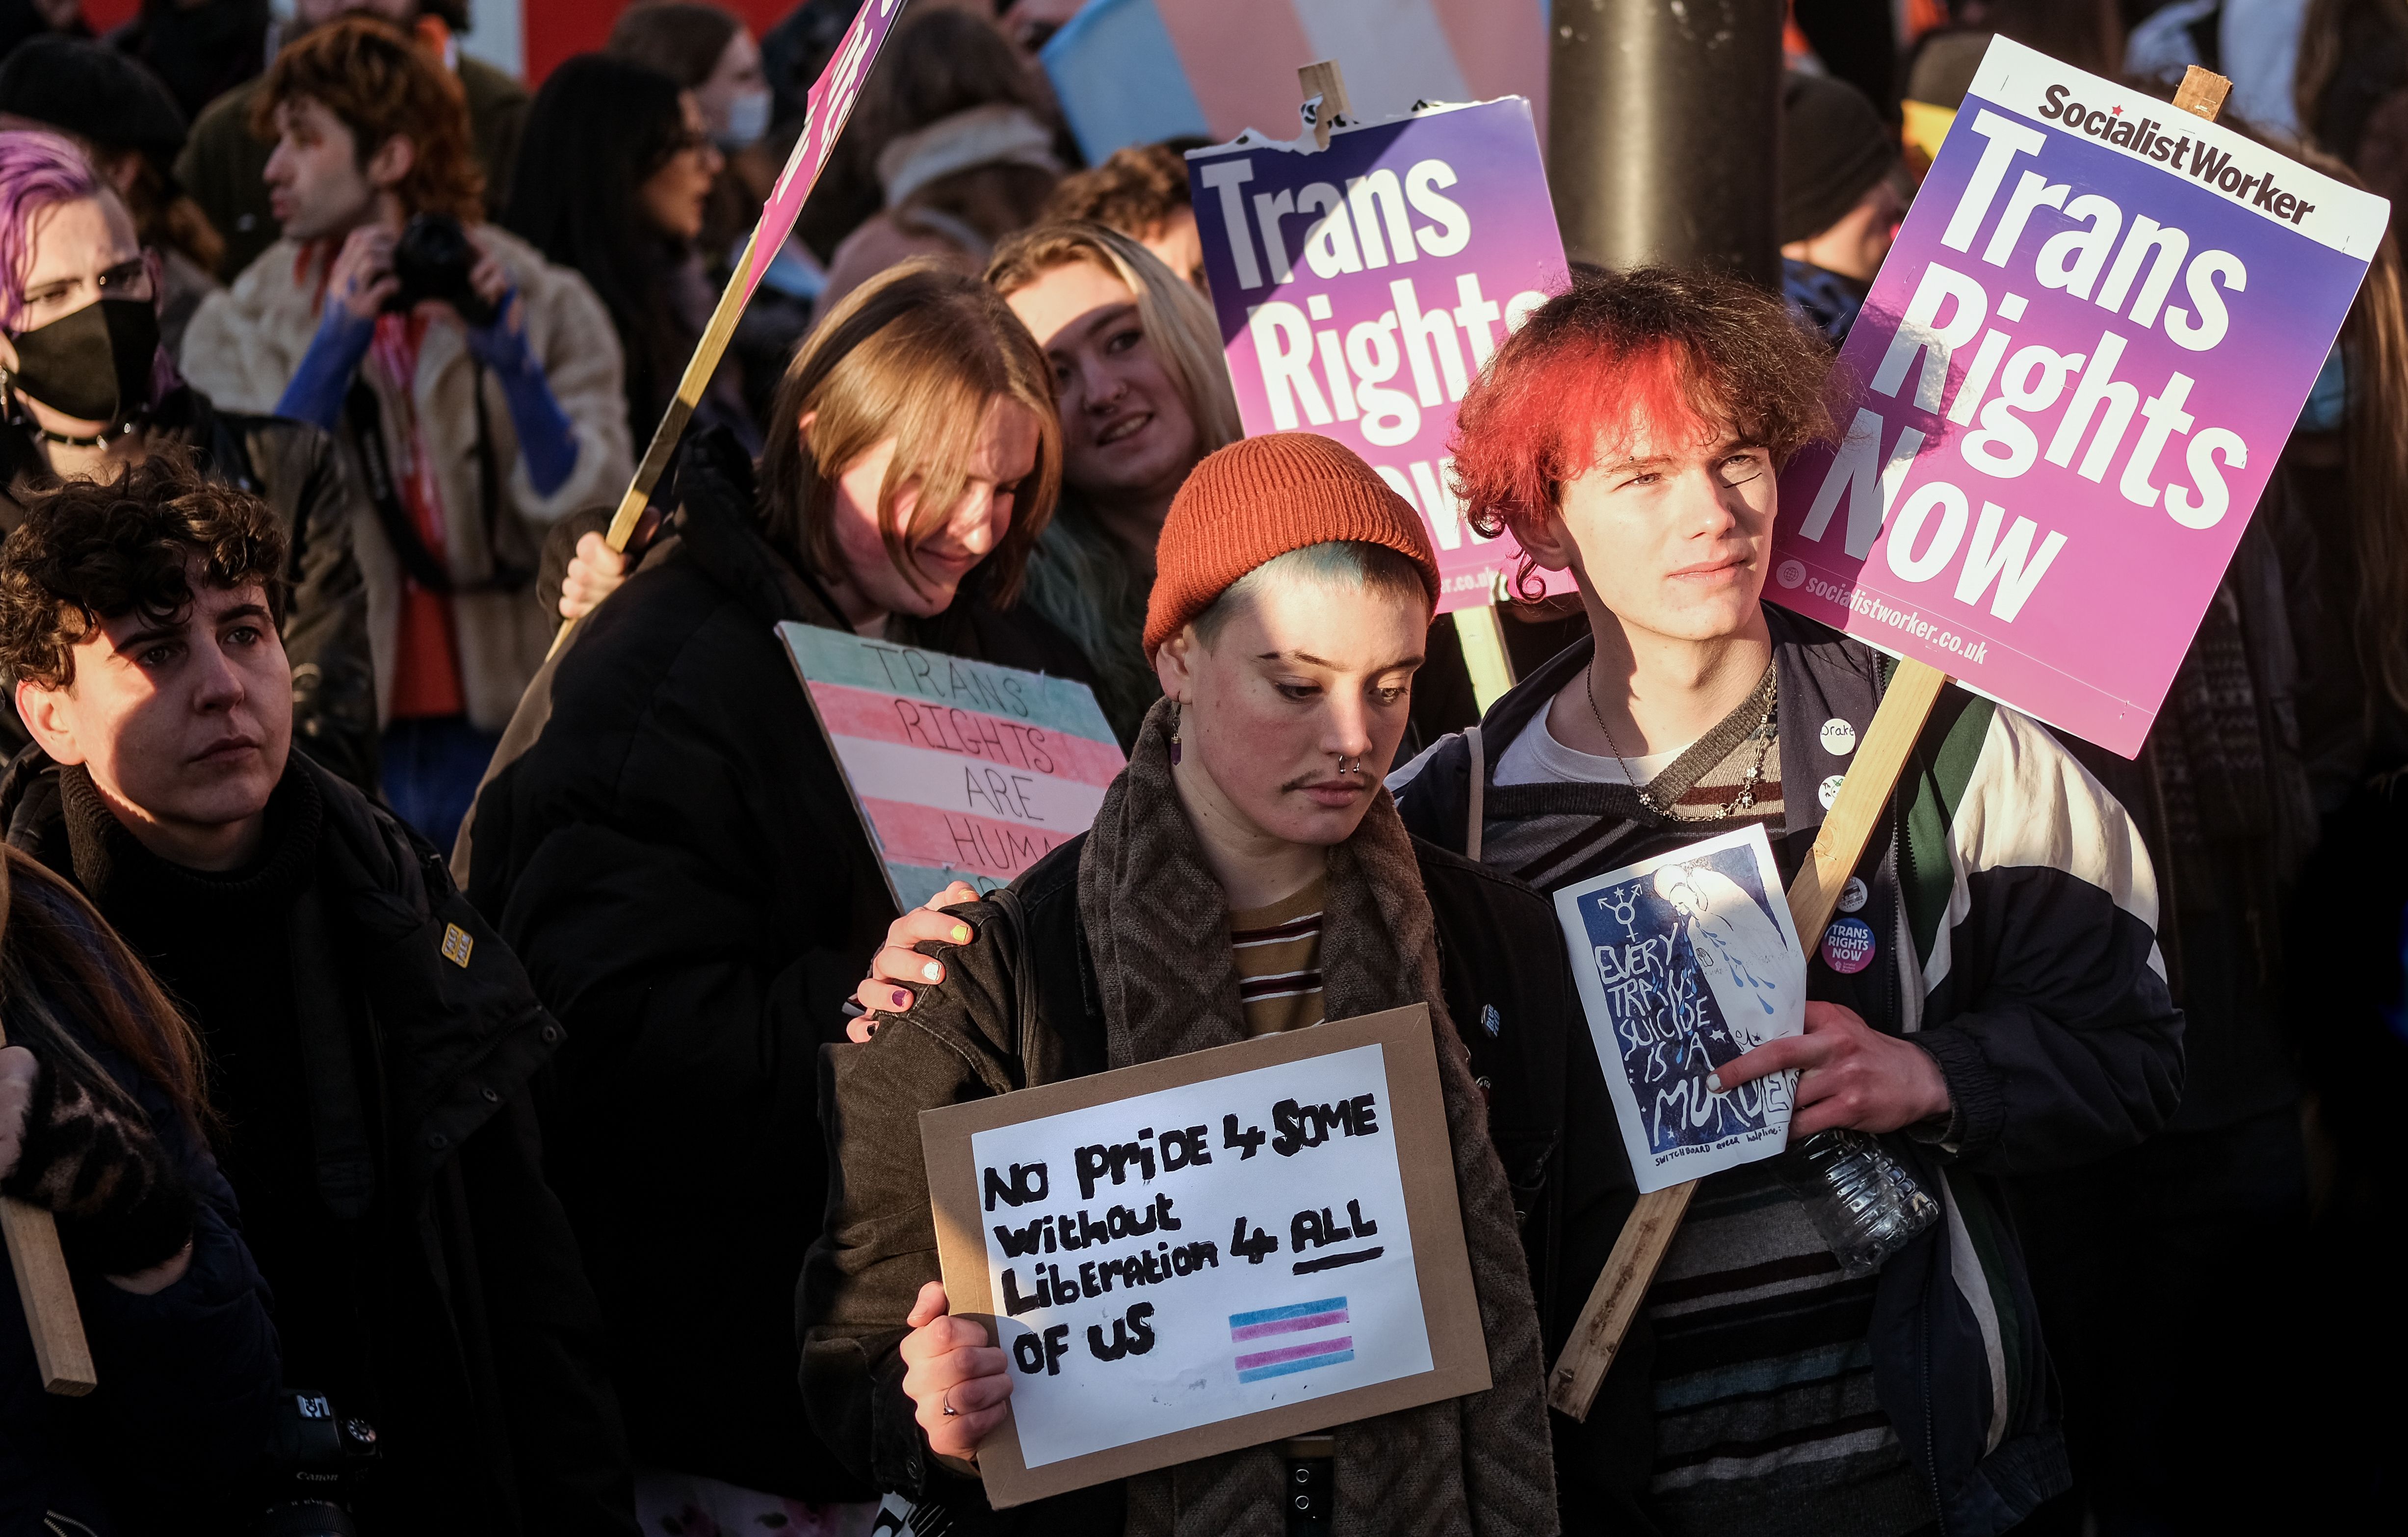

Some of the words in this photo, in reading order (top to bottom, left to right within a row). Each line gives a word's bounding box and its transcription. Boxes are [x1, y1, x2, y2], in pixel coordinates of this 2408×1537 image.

[1200, 158, 1471, 290] Trans
[1940, 108, 2248, 352] Trans
[1248, 273, 1550, 447] Right
[1870, 261, 2250, 530] Rights
[1798, 407, 2068, 624] Now
[1806, 576, 1989, 665] socialistworker.co.uk
[861, 643, 1028, 717] TRANS
[894, 699, 1054, 774] RIGHTS
[964, 766, 1045, 821] ARE
[445, 927, 459, 954] THEY
[1595, 922, 1678, 984] EVERY
[1828, 935, 1869, 951] RIGHTS
[1832, 924, 1868, 939] TRANS
[1832, 947, 1862, 962] NOW
[1620, 996, 1710, 1061] SUICIDE
[1644, 1041, 1667, 1083] IS
[1684, 1032, 1715, 1071] A
[983, 1159, 1049, 1211] NO
[1223, 1113, 1266, 1161] 4
[1272, 1092, 1379, 1157] SOME
[1655, 1144, 1711, 1166] SWITCHBOARD
[1230, 1216, 1279, 1264] 4
[1290, 1198, 1378, 1254] ALL
[1013, 1324, 1070, 1377] OF
[1087, 1301, 1155, 1363] US
[296, 1471, 339, 1481] Canon
